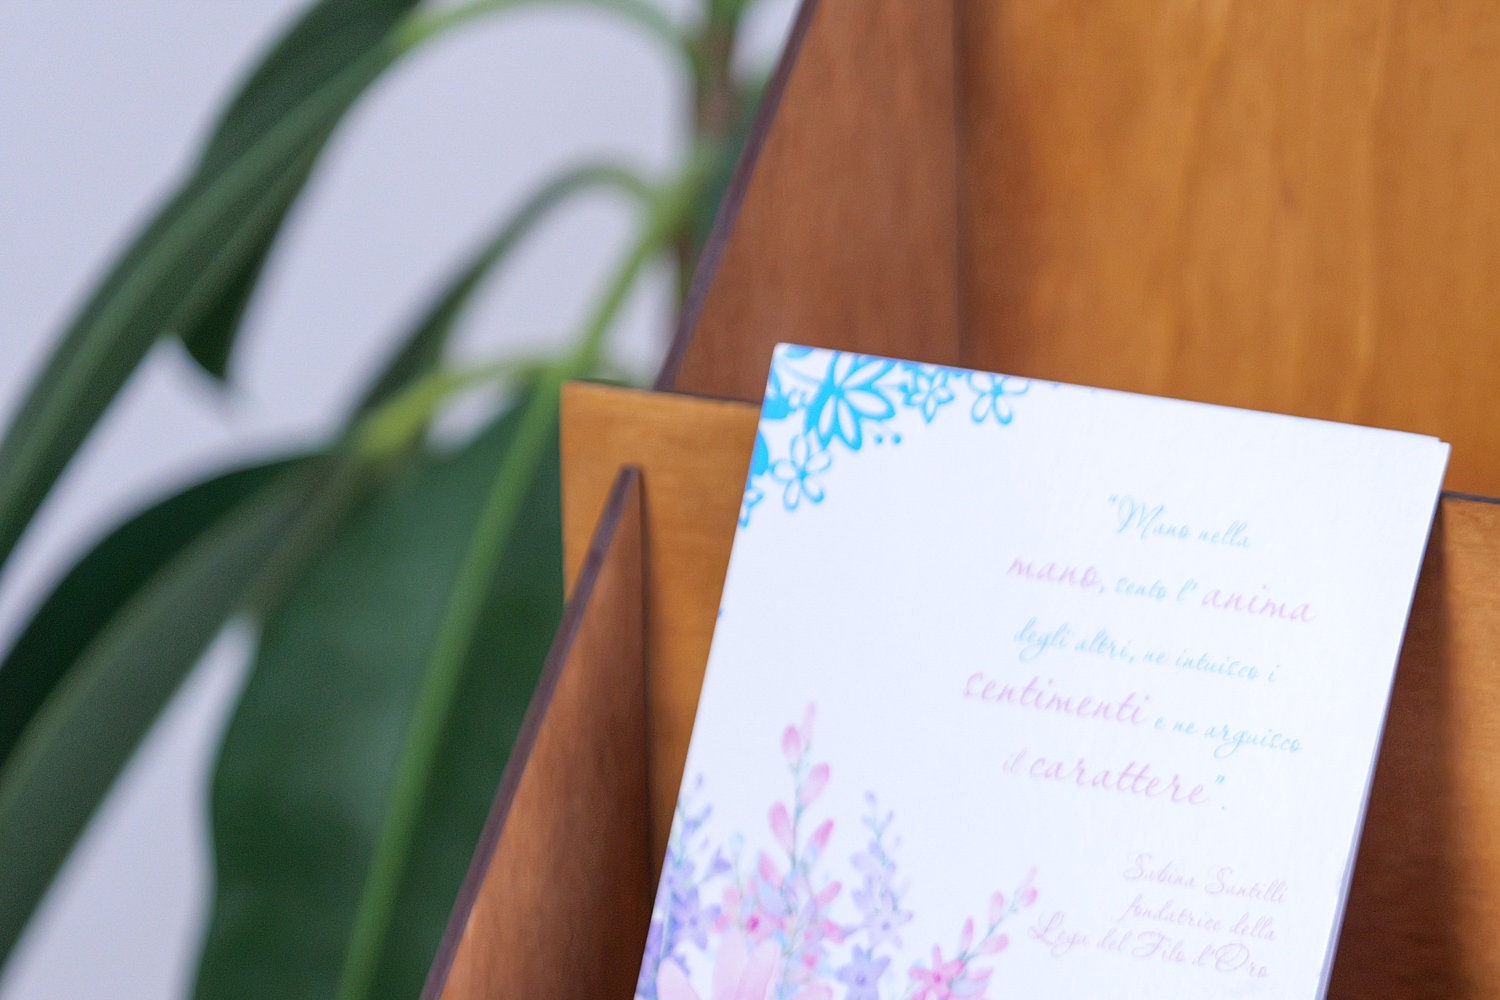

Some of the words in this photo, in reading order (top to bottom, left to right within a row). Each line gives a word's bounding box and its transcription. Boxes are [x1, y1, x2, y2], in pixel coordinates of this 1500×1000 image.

[1197, 521, 1250, 549] nella
[1006, 556, 1105, 594] mano,
[1114, 577, 1167, 600] sento
[1014, 616, 1072, 662] degli
[1074, 628, 1135, 663] altri,
[1142, 650, 1167, 665] ne
[1174, 649, 1259, 680] intuisco
[1268, 664, 1281, 683] i
[962, 671, 1151, 725] sentimenti
[1154, 717, 1166, 731] e
[1172, 720, 1195, 735] ne
[1204, 723, 1303, 760] arguisco
[1002, 747, 1029, 776] il
[1122, 851, 1197, 889] Sabina
[1204, 866, 1289, 905] Santilli
[1027, 910, 1089, 958] Lega
[1096, 926, 1133, 952] del
[1131, 930, 1186, 963] Filo
[1228, 911, 1278, 941] della
